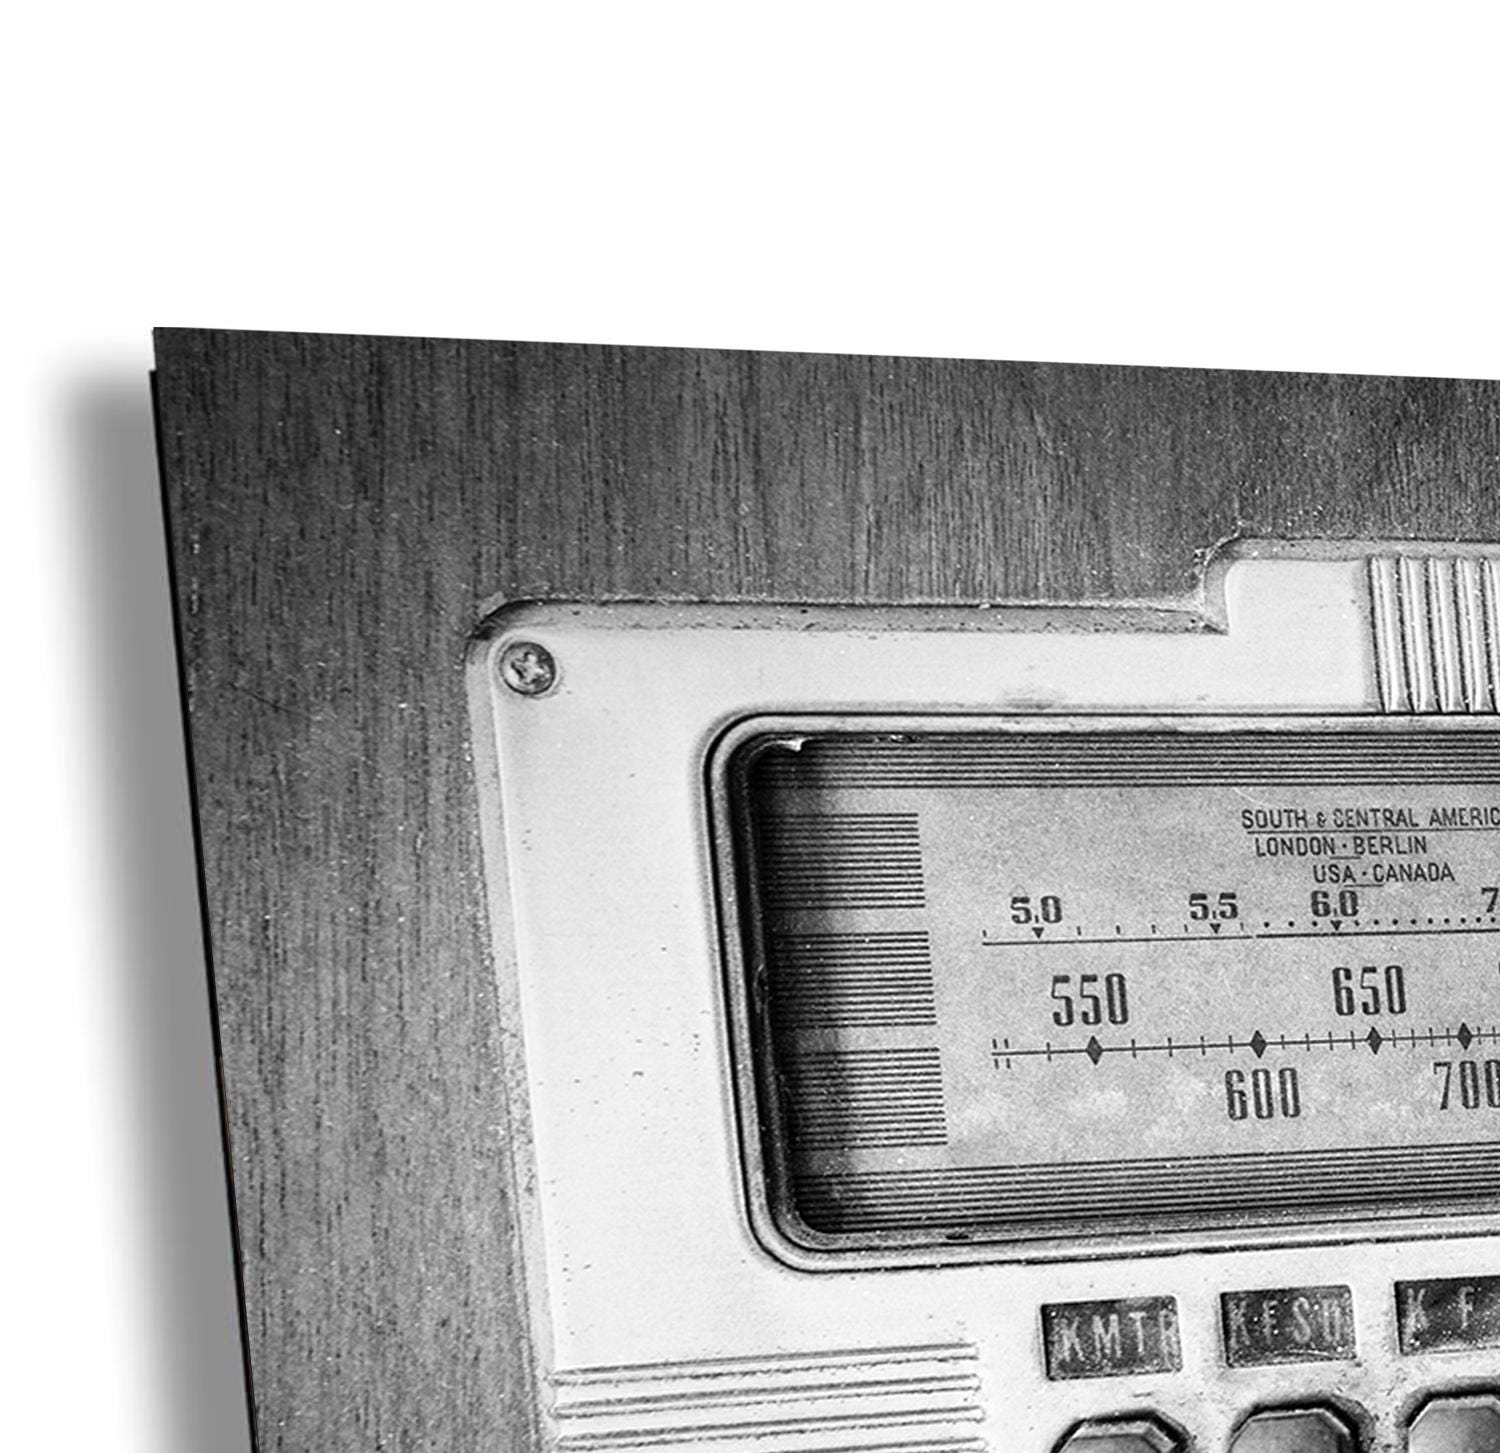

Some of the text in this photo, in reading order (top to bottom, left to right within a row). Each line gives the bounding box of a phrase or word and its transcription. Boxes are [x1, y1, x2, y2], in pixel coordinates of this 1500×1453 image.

[1242, 809, 1307, 829] SOUTH
[1334, 808, 1420, 828] CENTRAL
[1255, 835, 1427, 857] LONDON BERLIN
[1313, 862, 1455, 883] USA CANADA
[1010, 895, 1063, 924] 5.0
[1188, 892, 1239, 920] 5.5
[1310, 889, 1359, 917] 6.0
[1051, 973, 1129, 1026] 550
[1333, 965, 1408, 1016] 650
[1225, 1067, 1302, 1120] 600
